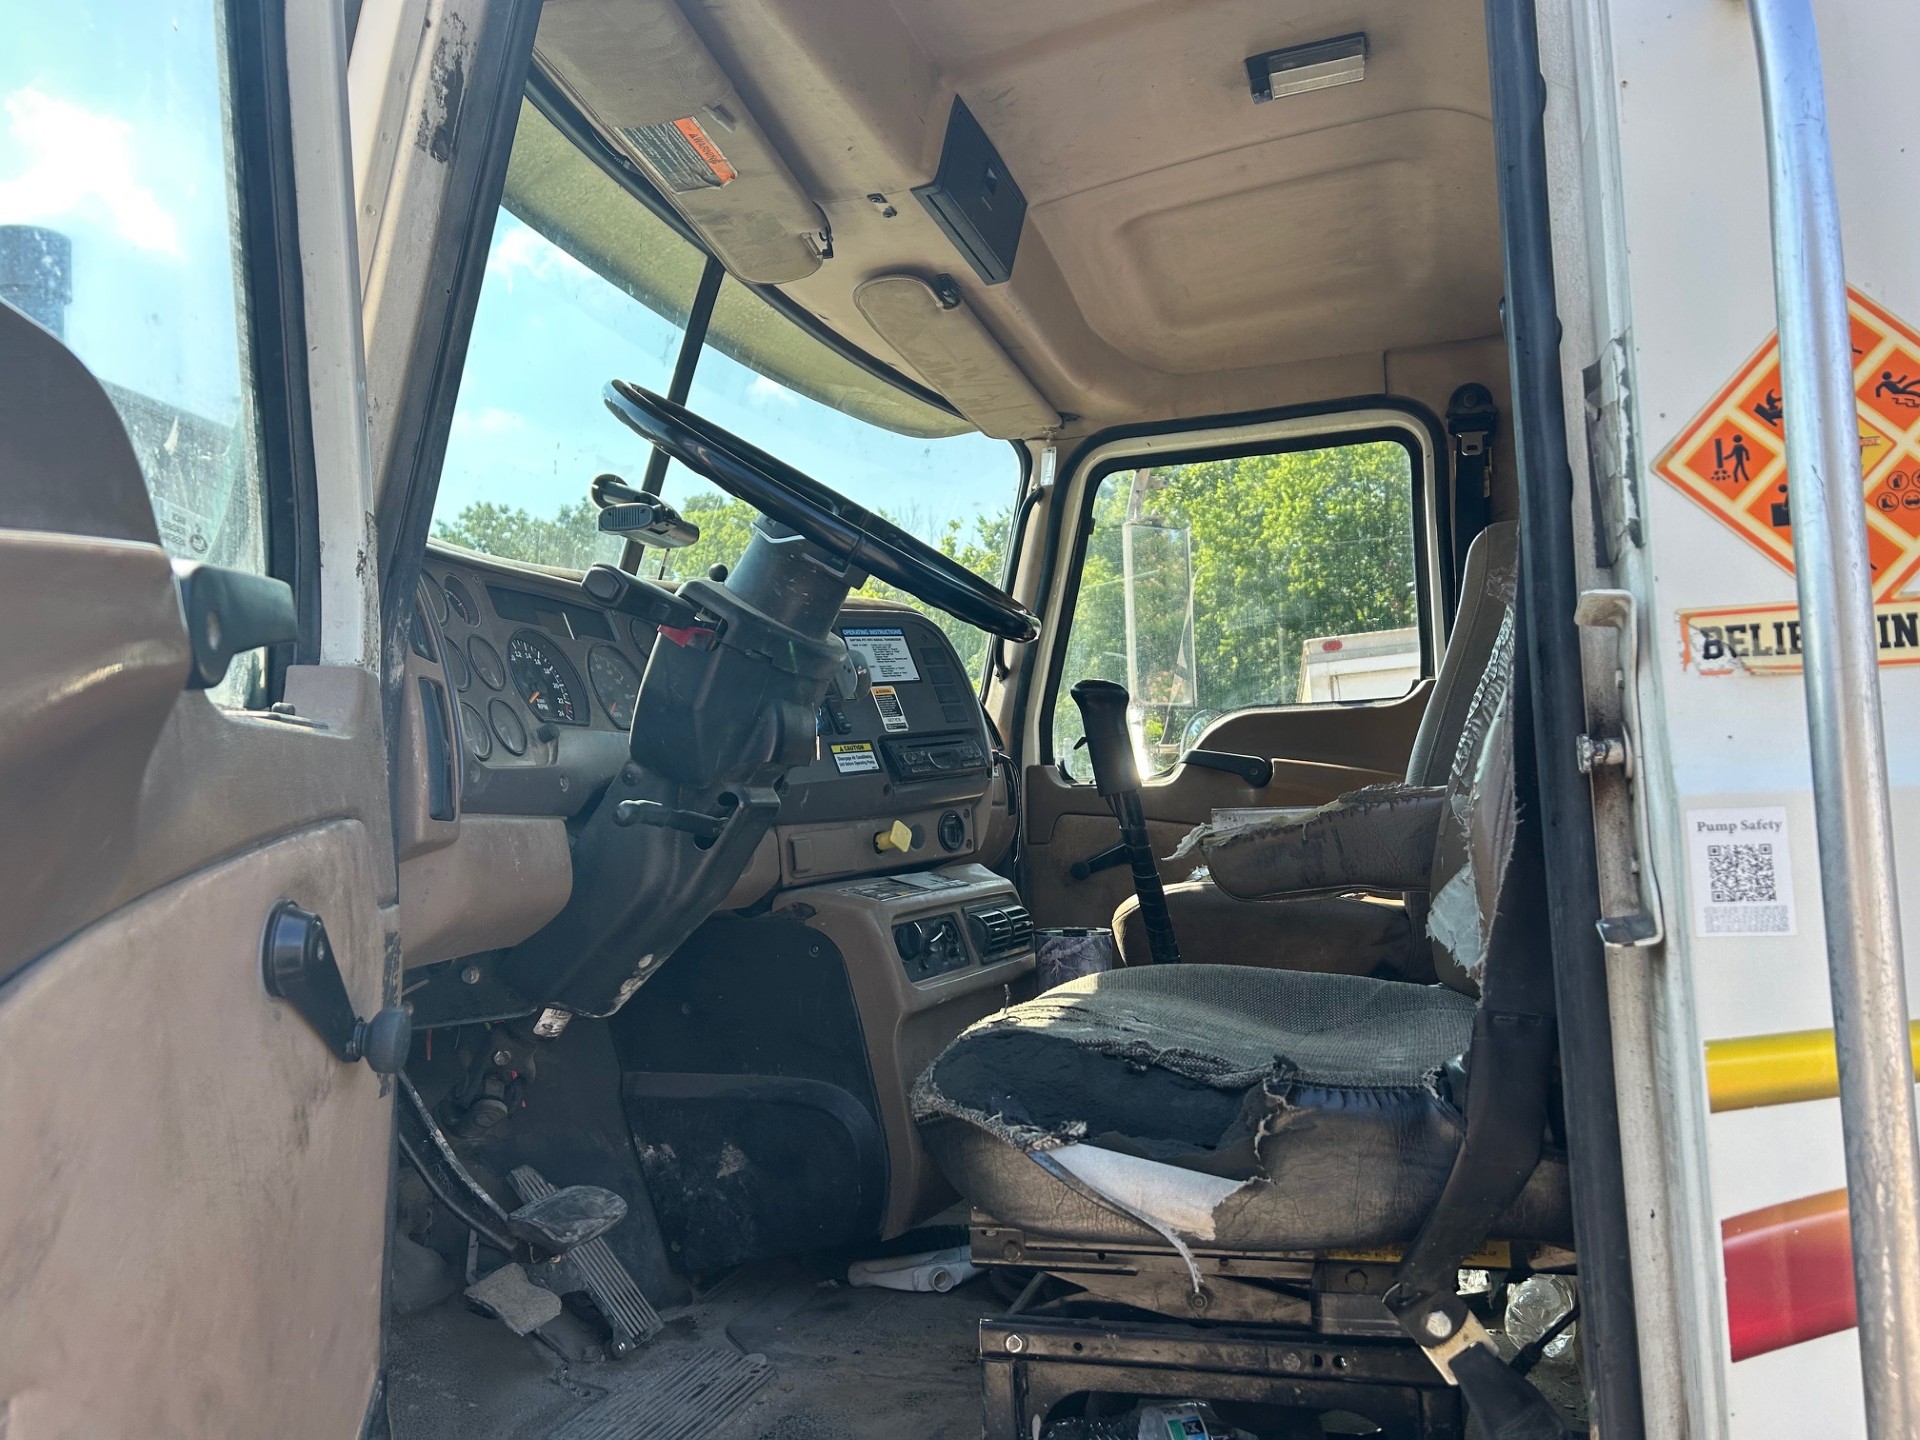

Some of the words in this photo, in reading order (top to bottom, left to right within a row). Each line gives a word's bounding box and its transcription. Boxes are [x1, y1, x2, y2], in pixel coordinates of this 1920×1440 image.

[693, 136, 721, 164] WARNING
[1877, 612, 1919, 649] IN
[537, 703, 549, 711] RPM
[1697, 821, 1738, 834] Pump
[1740, 818, 1783, 833] Safety
